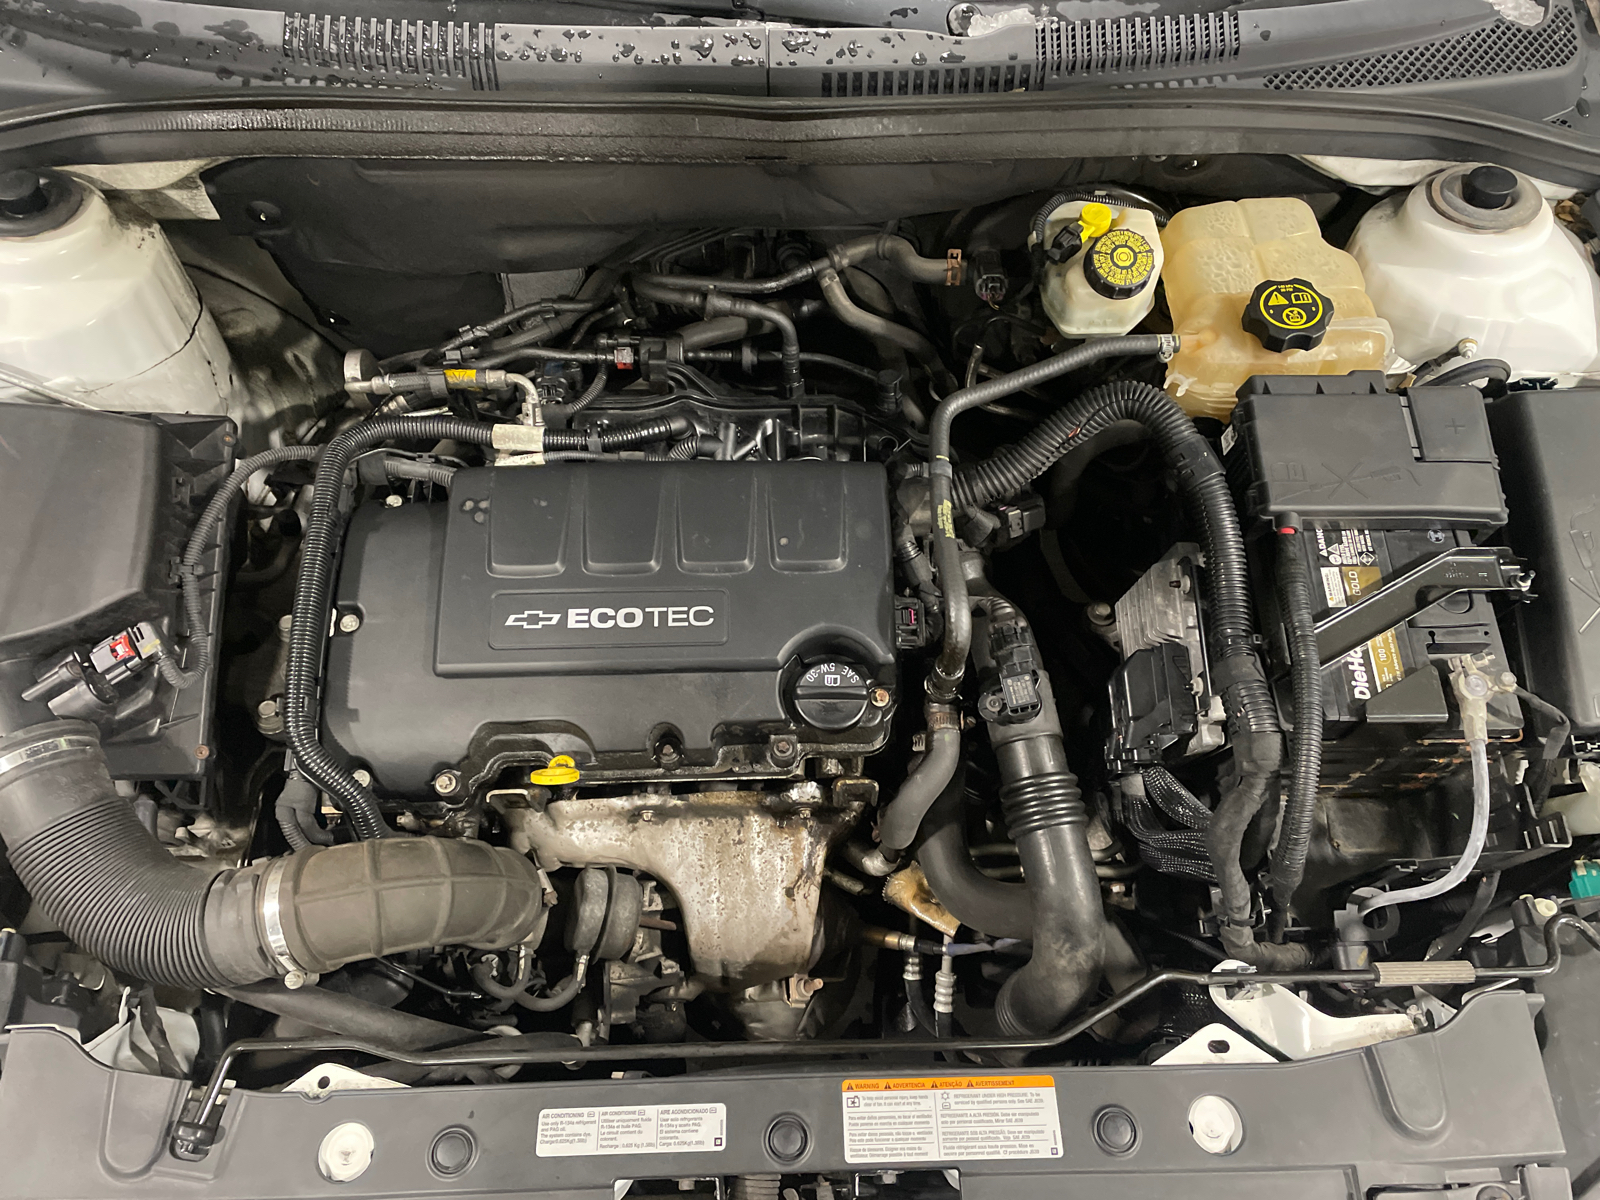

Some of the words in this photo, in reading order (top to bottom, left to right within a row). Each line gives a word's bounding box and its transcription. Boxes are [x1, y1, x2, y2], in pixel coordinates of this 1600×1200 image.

[1349, 571, 1361, 595] GOLD
[567, 606, 714, 628] ECOTEC
[1378, 648, 1387, 661] 100
[806, 662, 835, 682] 5W-30
[841, 665, 860, 683] SAE
[938, 1080, 962, 1088] ATENÇÃO
